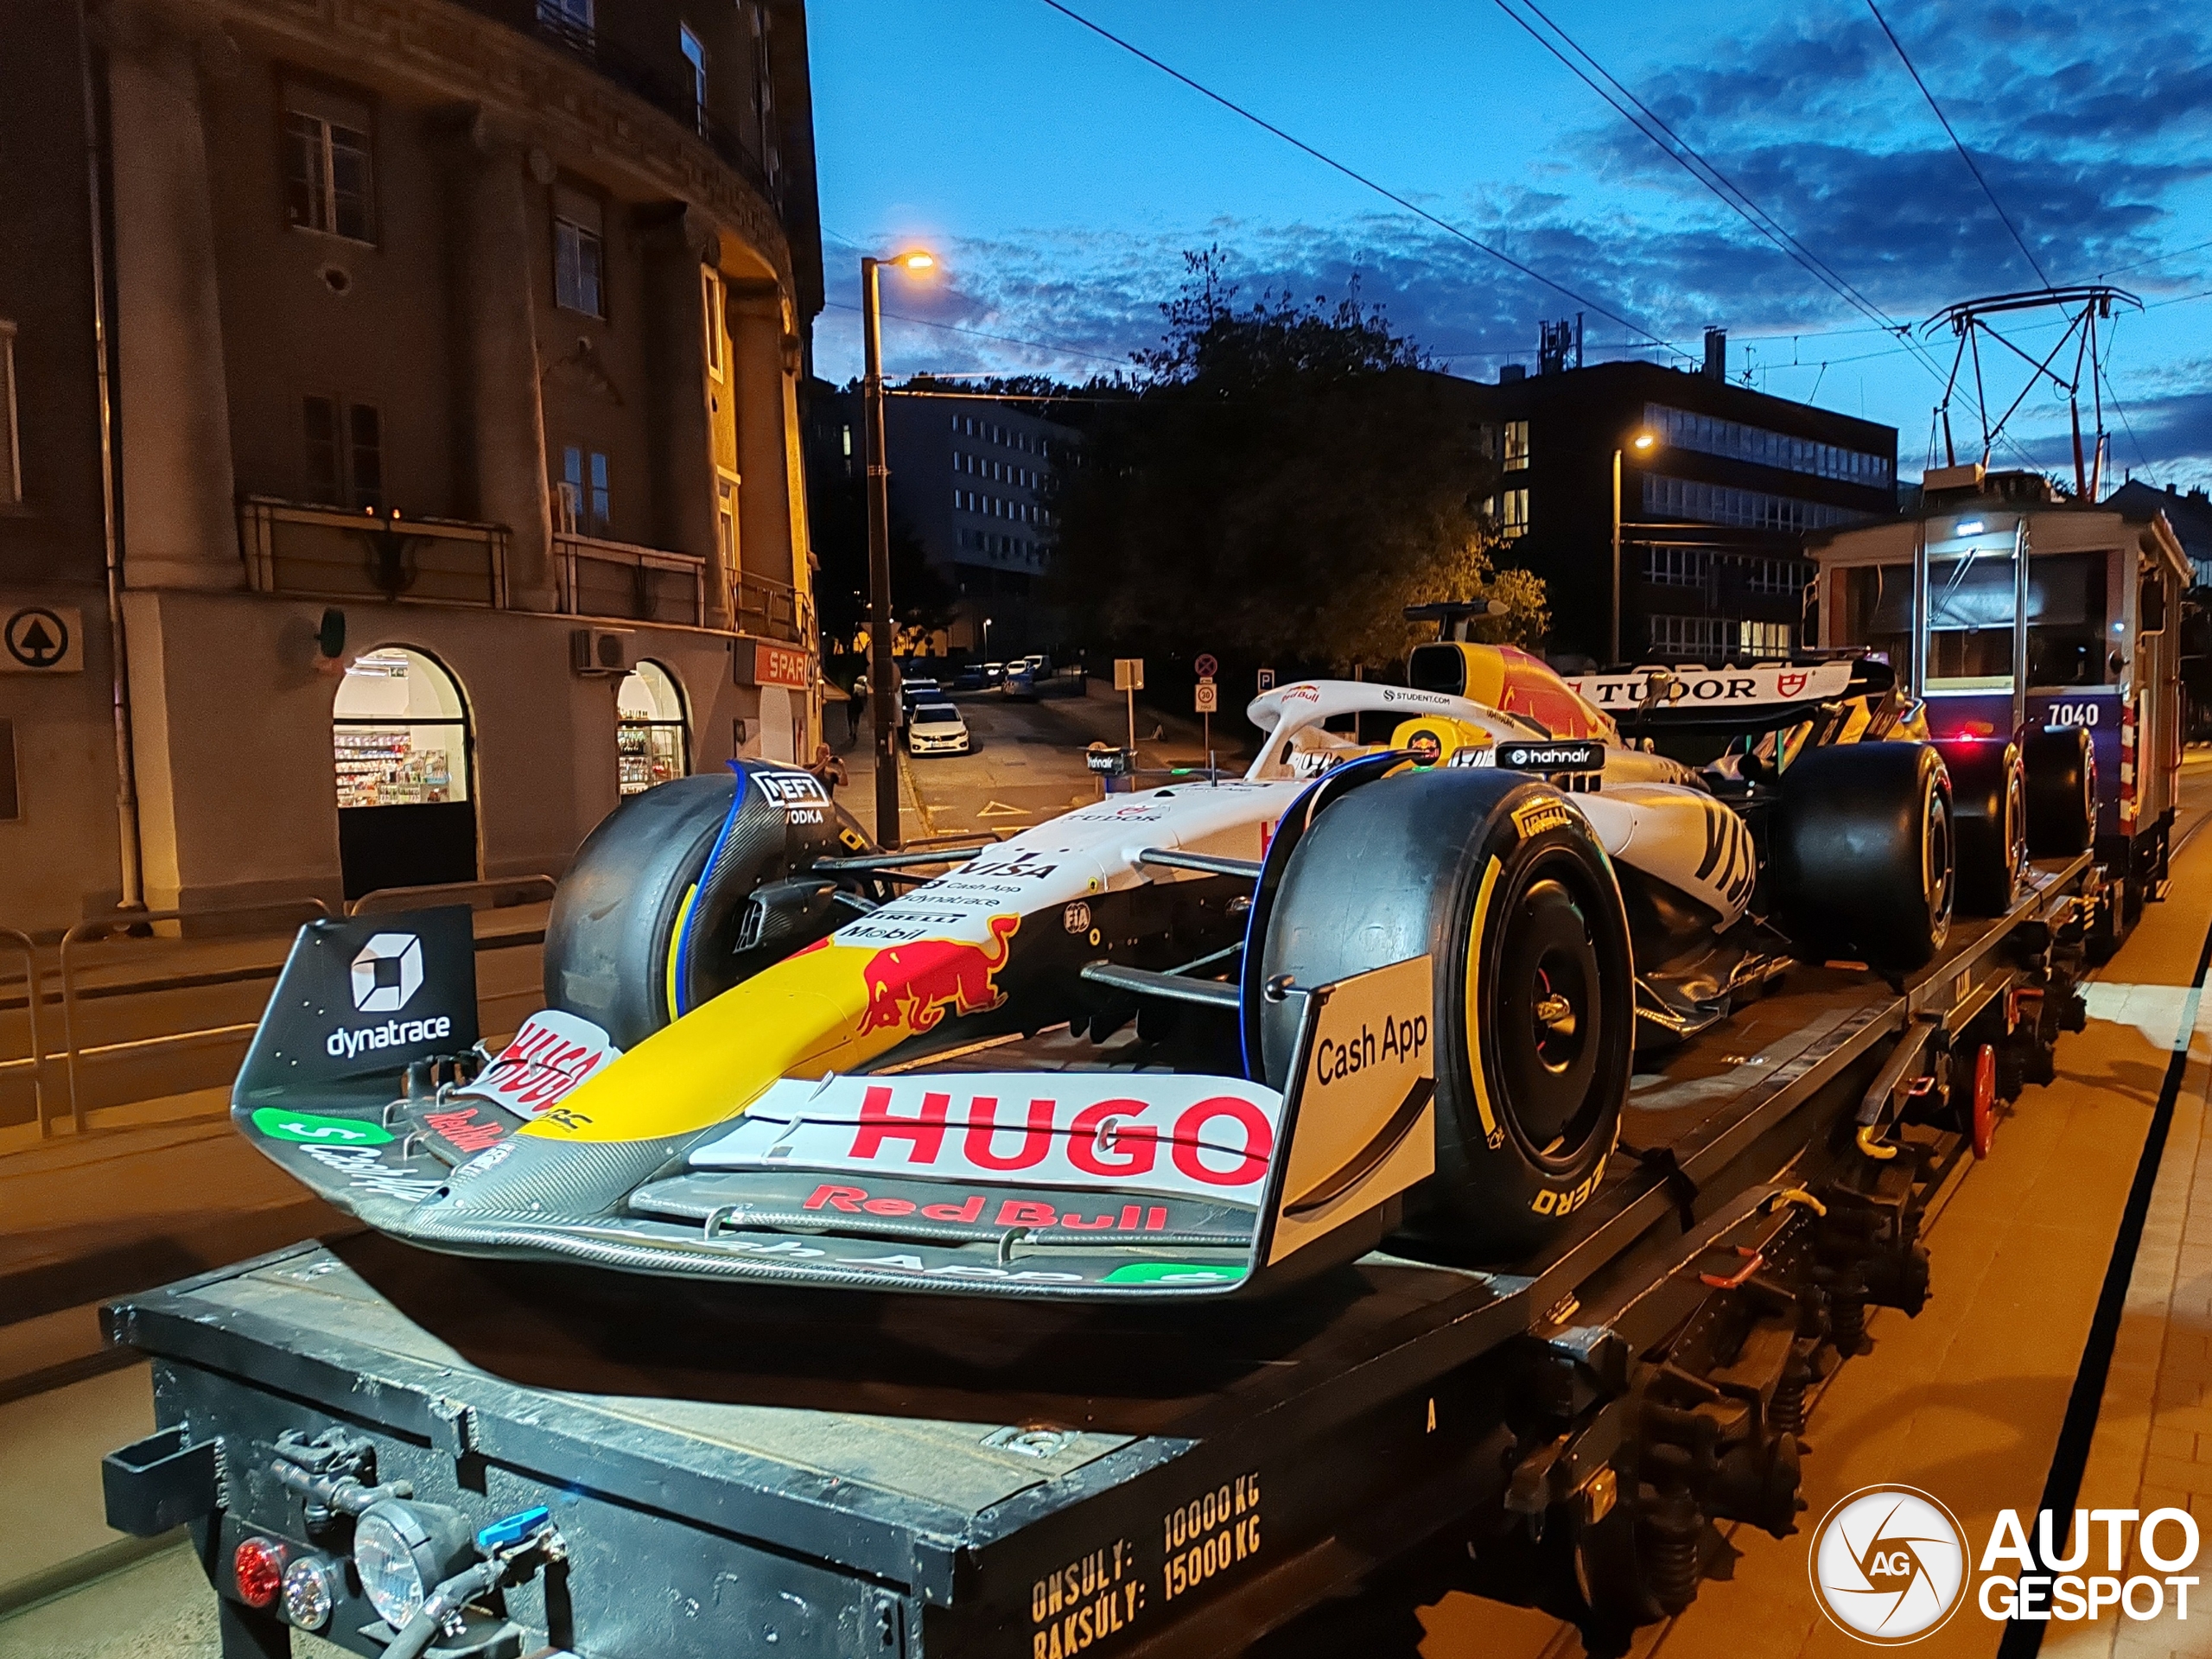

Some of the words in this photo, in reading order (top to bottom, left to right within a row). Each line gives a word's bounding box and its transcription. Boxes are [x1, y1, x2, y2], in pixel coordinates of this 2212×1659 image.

[769, 652, 804, 681] SPAR
[1262, 674, 1270, 687] P
[1596, 678, 1758, 703] TUDOR
[1281, 691, 1298, 704] Red
[1297, 691, 1320, 703] Bull
[1396, 692, 1451, 705] STUDENT.COM
[2049, 703, 2099, 726] 7040
[1530, 747, 1591, 763] hahnair
[764, 778, 818, 799] NEFT
[1059, 815, 1162, 823] TUDOR
[957, 862, 1059, 880] VISA
[946, 881, 986, 891] Cash
[986, 883, 1021, 893] App
[908, 893, 1001, 907] dynatrace
[865, 910, 968, 924] PIRELLI
[1065, 907, 1089, 928] FIA
[840, 925, 929, 940] Mobil
[327, 1015, 451, 1059] dynatrace
[1317, 1023, 1376, 1086] Cash
[1381, 1014, 1427, 1065] App
[847, 1085, 1274, 1186] HUGO
[1531, 1152, 1607, 1217] ZERO
[803, 1184, 986, 1224] Red
[994, 1201, 1167, 1231] Bull
[1164, 1484, 1230, 1554] 10000
[1235, 1471, 1260, 1516] KG
[1164, 1530, 1231, 1602] 15000
[1235, 1513, 1261, 1561] KG
